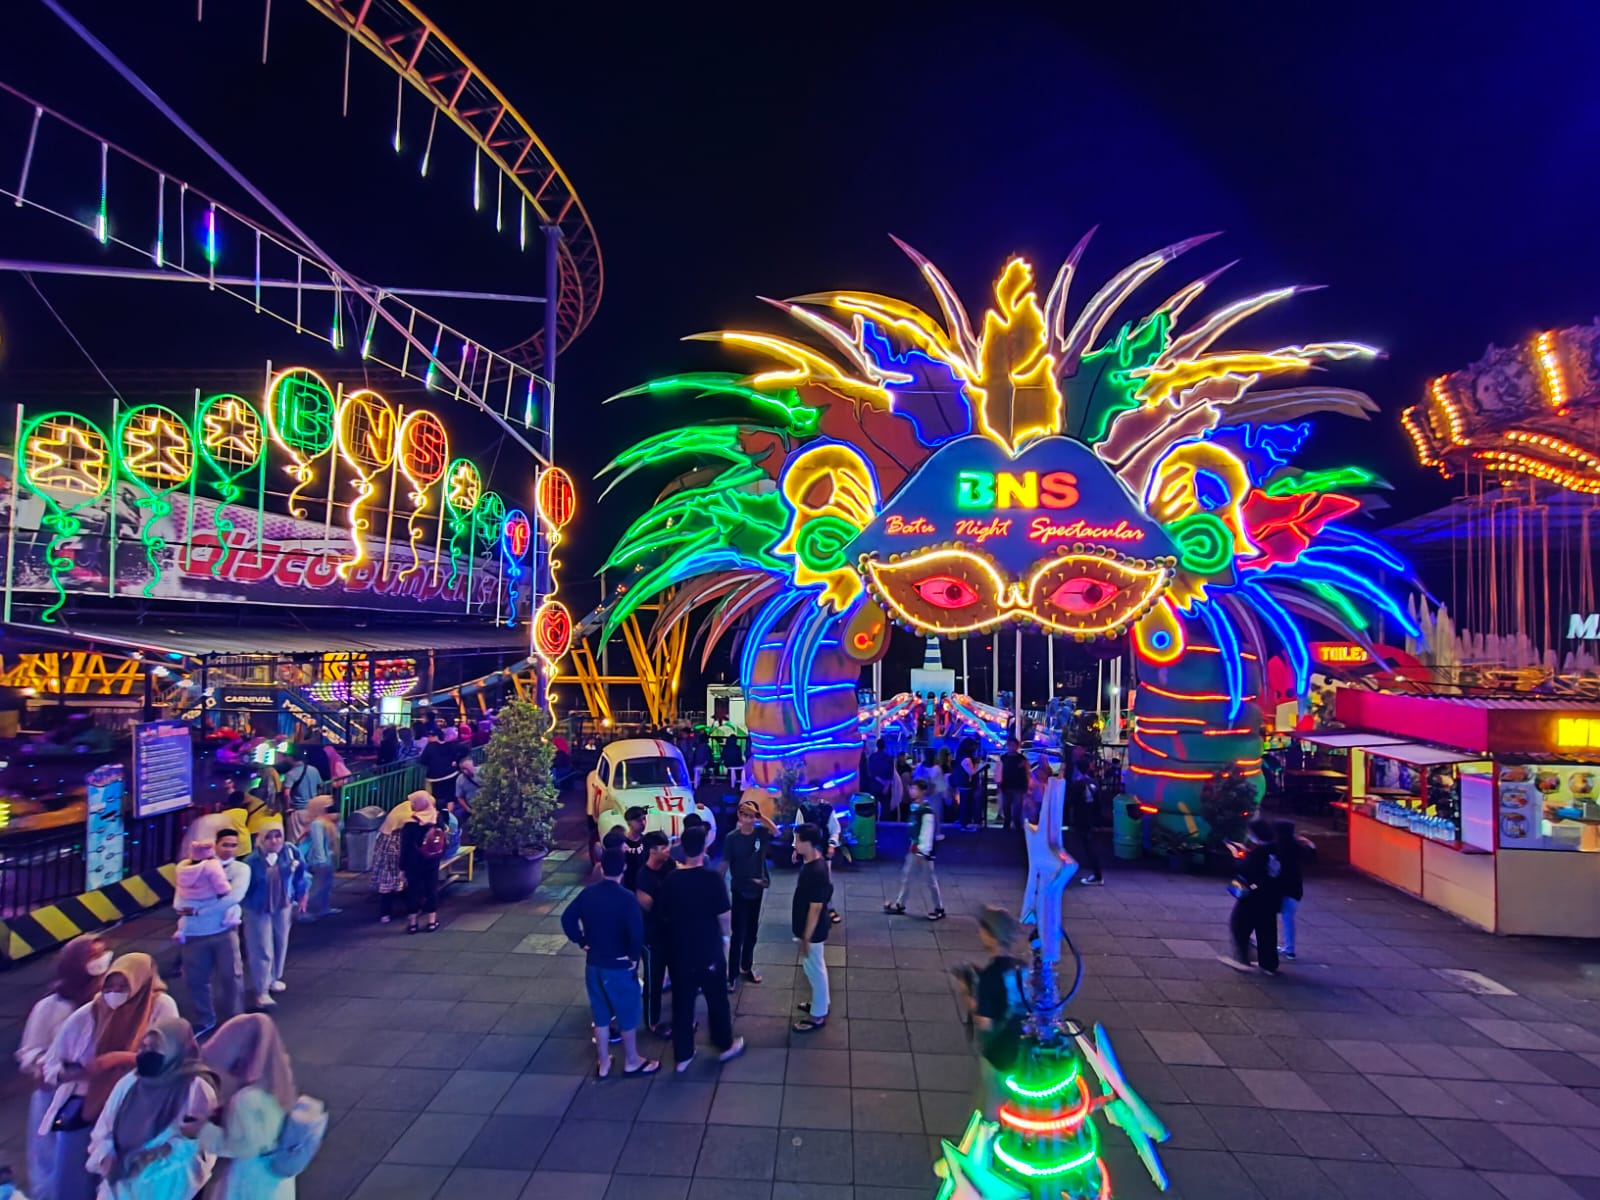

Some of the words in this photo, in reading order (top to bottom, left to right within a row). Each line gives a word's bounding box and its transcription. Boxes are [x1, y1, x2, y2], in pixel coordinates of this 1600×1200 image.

[278, 377, 445, 483] BNS
[957, 470, 1080, 509] BNS
[885, 515, 936, 535] Batu
[955, 517, 1012, 543] Night
[1029, 517, 1145, 544] Spectacular
[224, 695, 274, 704] CARNIVAL
